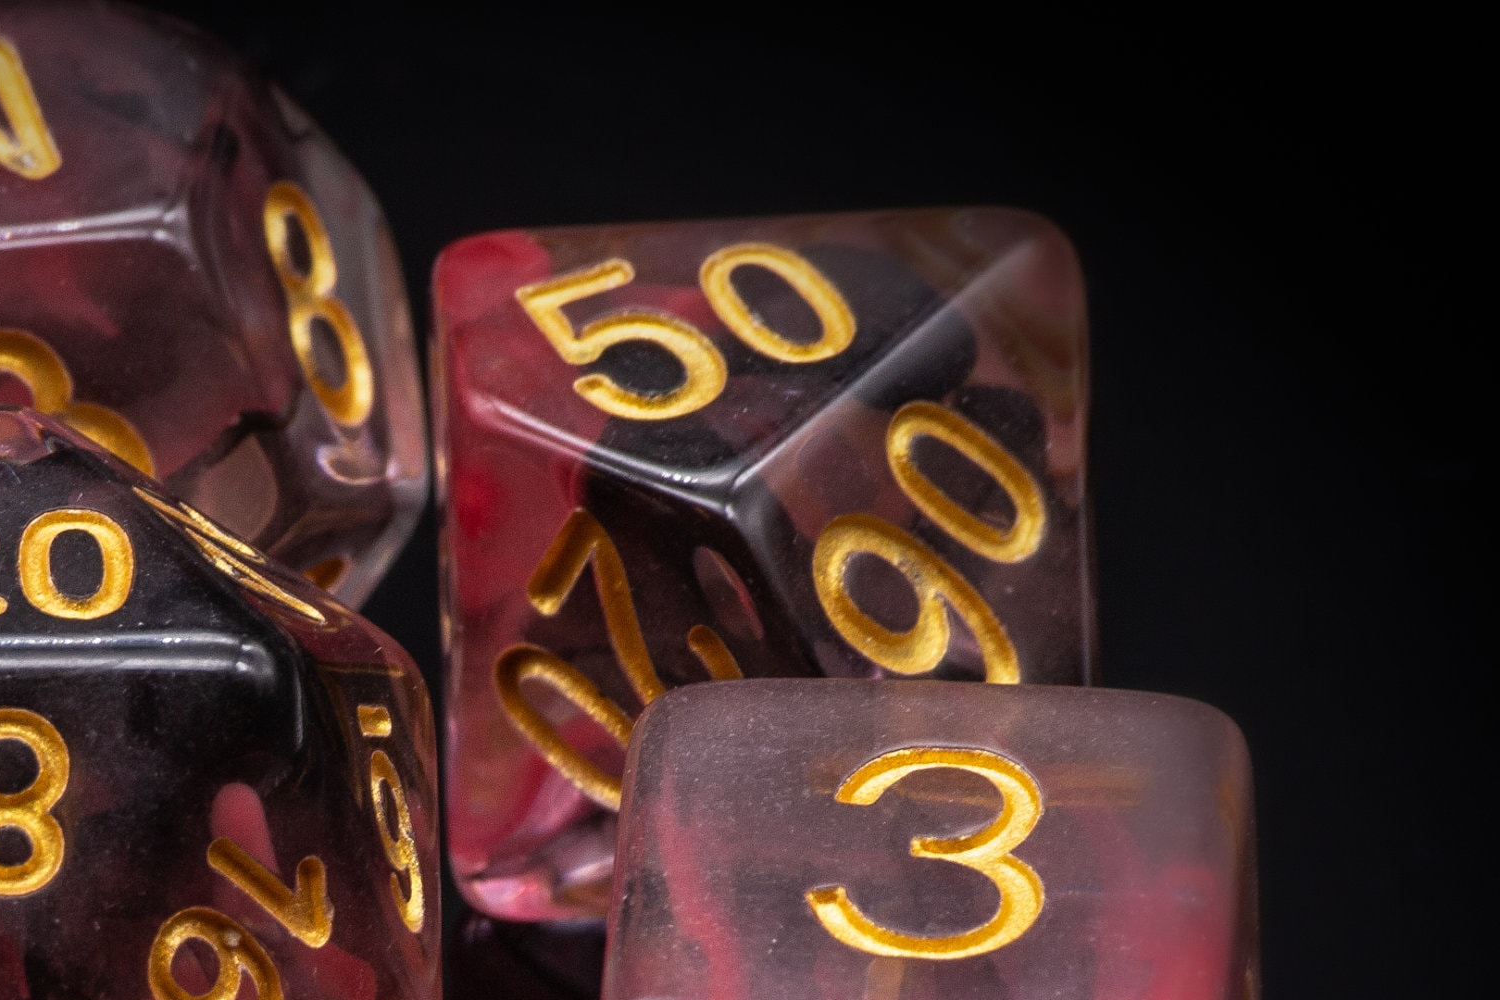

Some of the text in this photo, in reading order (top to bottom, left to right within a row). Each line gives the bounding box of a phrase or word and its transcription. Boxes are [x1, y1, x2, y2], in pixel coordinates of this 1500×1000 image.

[263, 182, 374, 427] 8
[515, 242, 857, 420] 50
[811, 400, 1046, 684] 90
[804, 745, 1046, 961] 3
